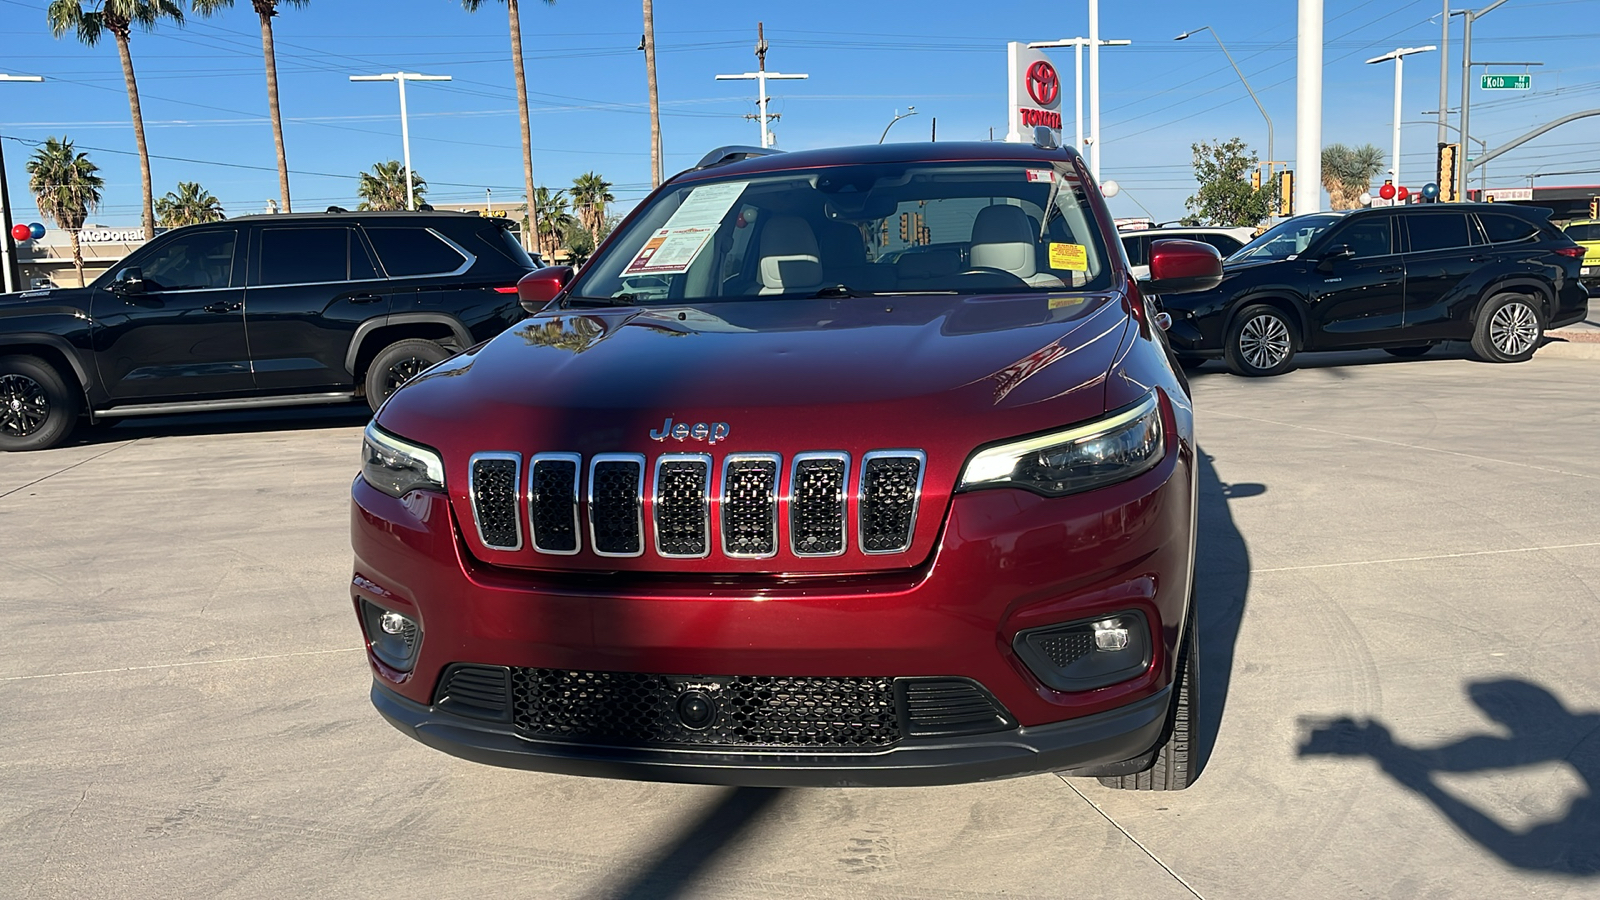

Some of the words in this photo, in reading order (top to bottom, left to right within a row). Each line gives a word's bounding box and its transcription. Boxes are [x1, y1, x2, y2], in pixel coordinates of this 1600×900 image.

[1486, 76, 1504, 88] Kolb
[1020, 108, 1062, 129] TOYOTA
[649, 418, 730, 445] Jeep
